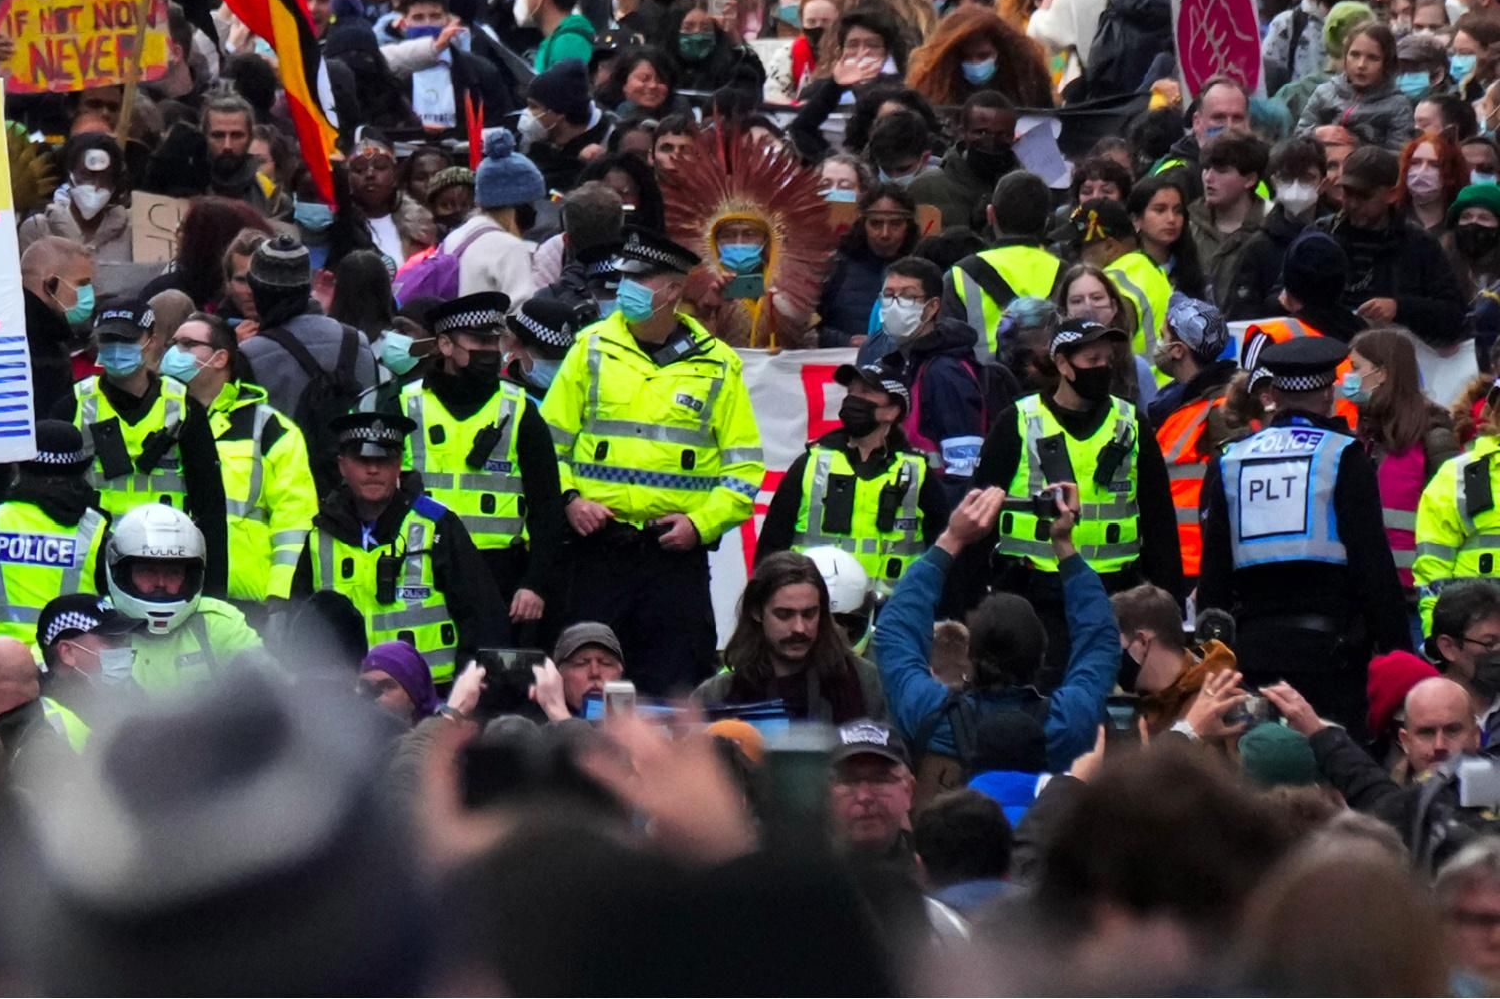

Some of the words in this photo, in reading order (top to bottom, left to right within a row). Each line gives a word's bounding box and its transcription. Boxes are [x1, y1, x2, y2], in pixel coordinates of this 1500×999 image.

[6, 8, 30, 38] IF
[38, 4, 84, 32] NOT
[28, 35, 143, 84] NEVER
[1250, 433, 1320, 455] POLICE
[1249, 475, 1297, 502] PLT
[140, 545, 186, 557] POLICE
[398, 588, 429, 599] POLICE
